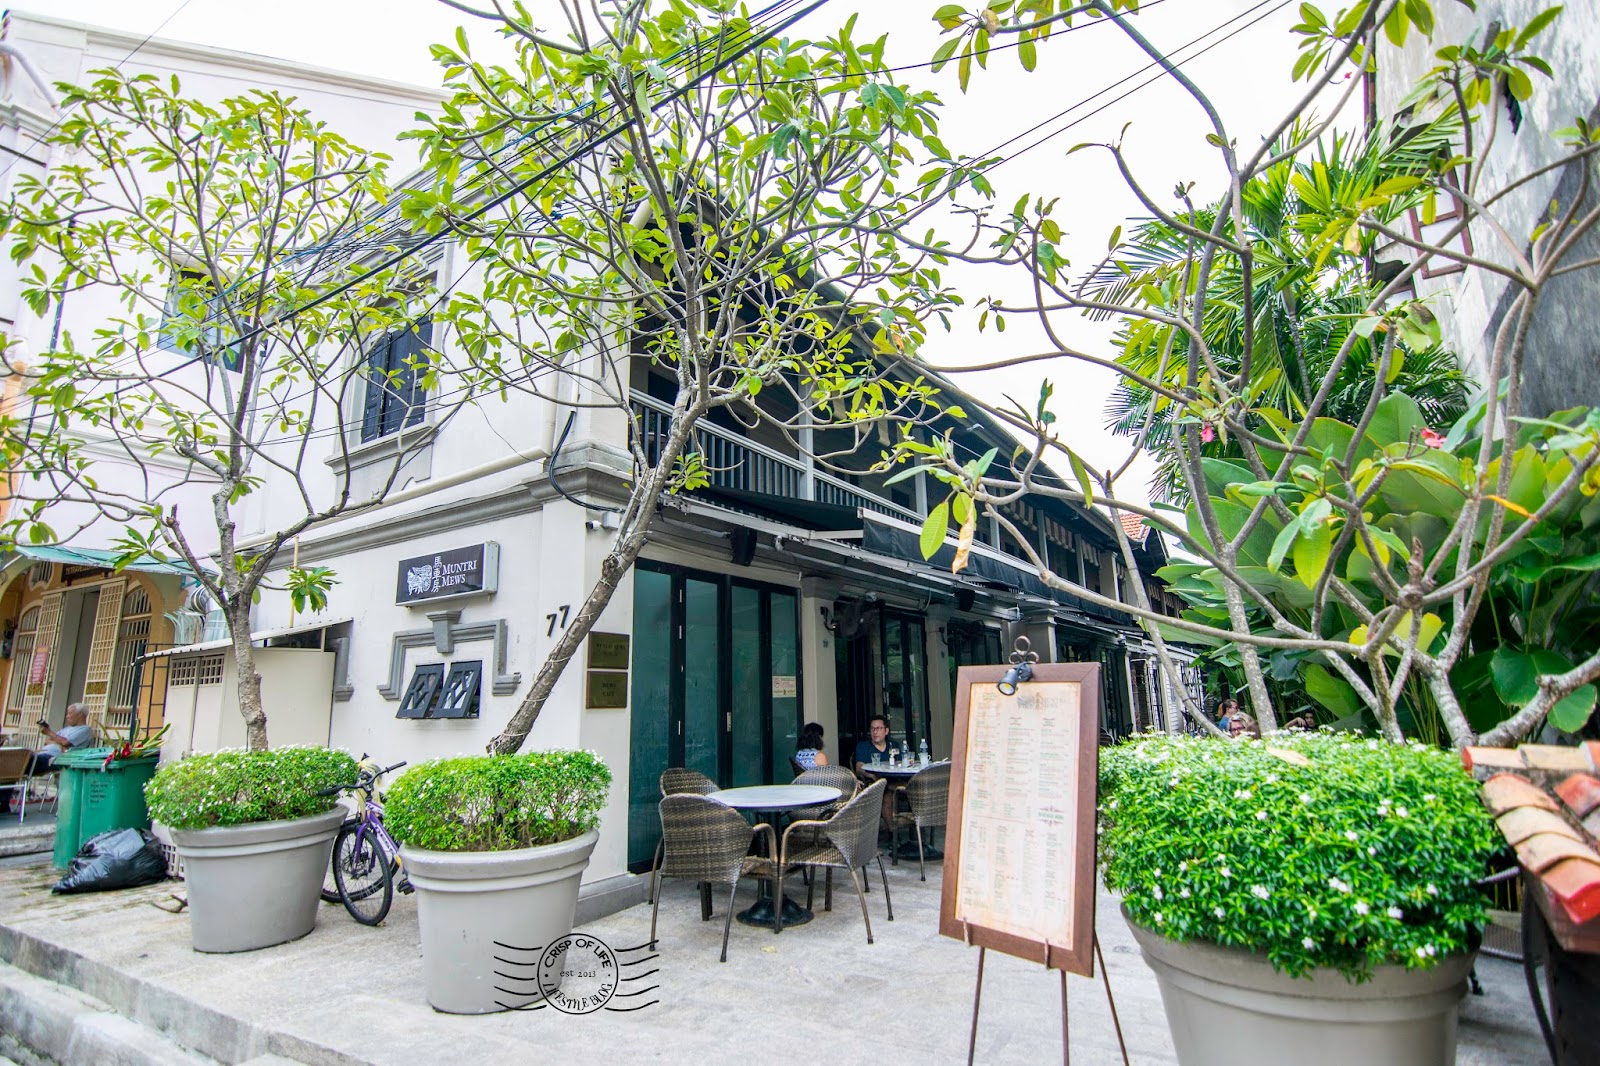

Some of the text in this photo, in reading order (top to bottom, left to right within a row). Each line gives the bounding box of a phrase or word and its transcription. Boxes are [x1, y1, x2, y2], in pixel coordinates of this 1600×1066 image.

[442, 560, 478, 575] MUNTRI
[442, 574, 466, 587] MEWS
[546, 605, 570, 637] 77
